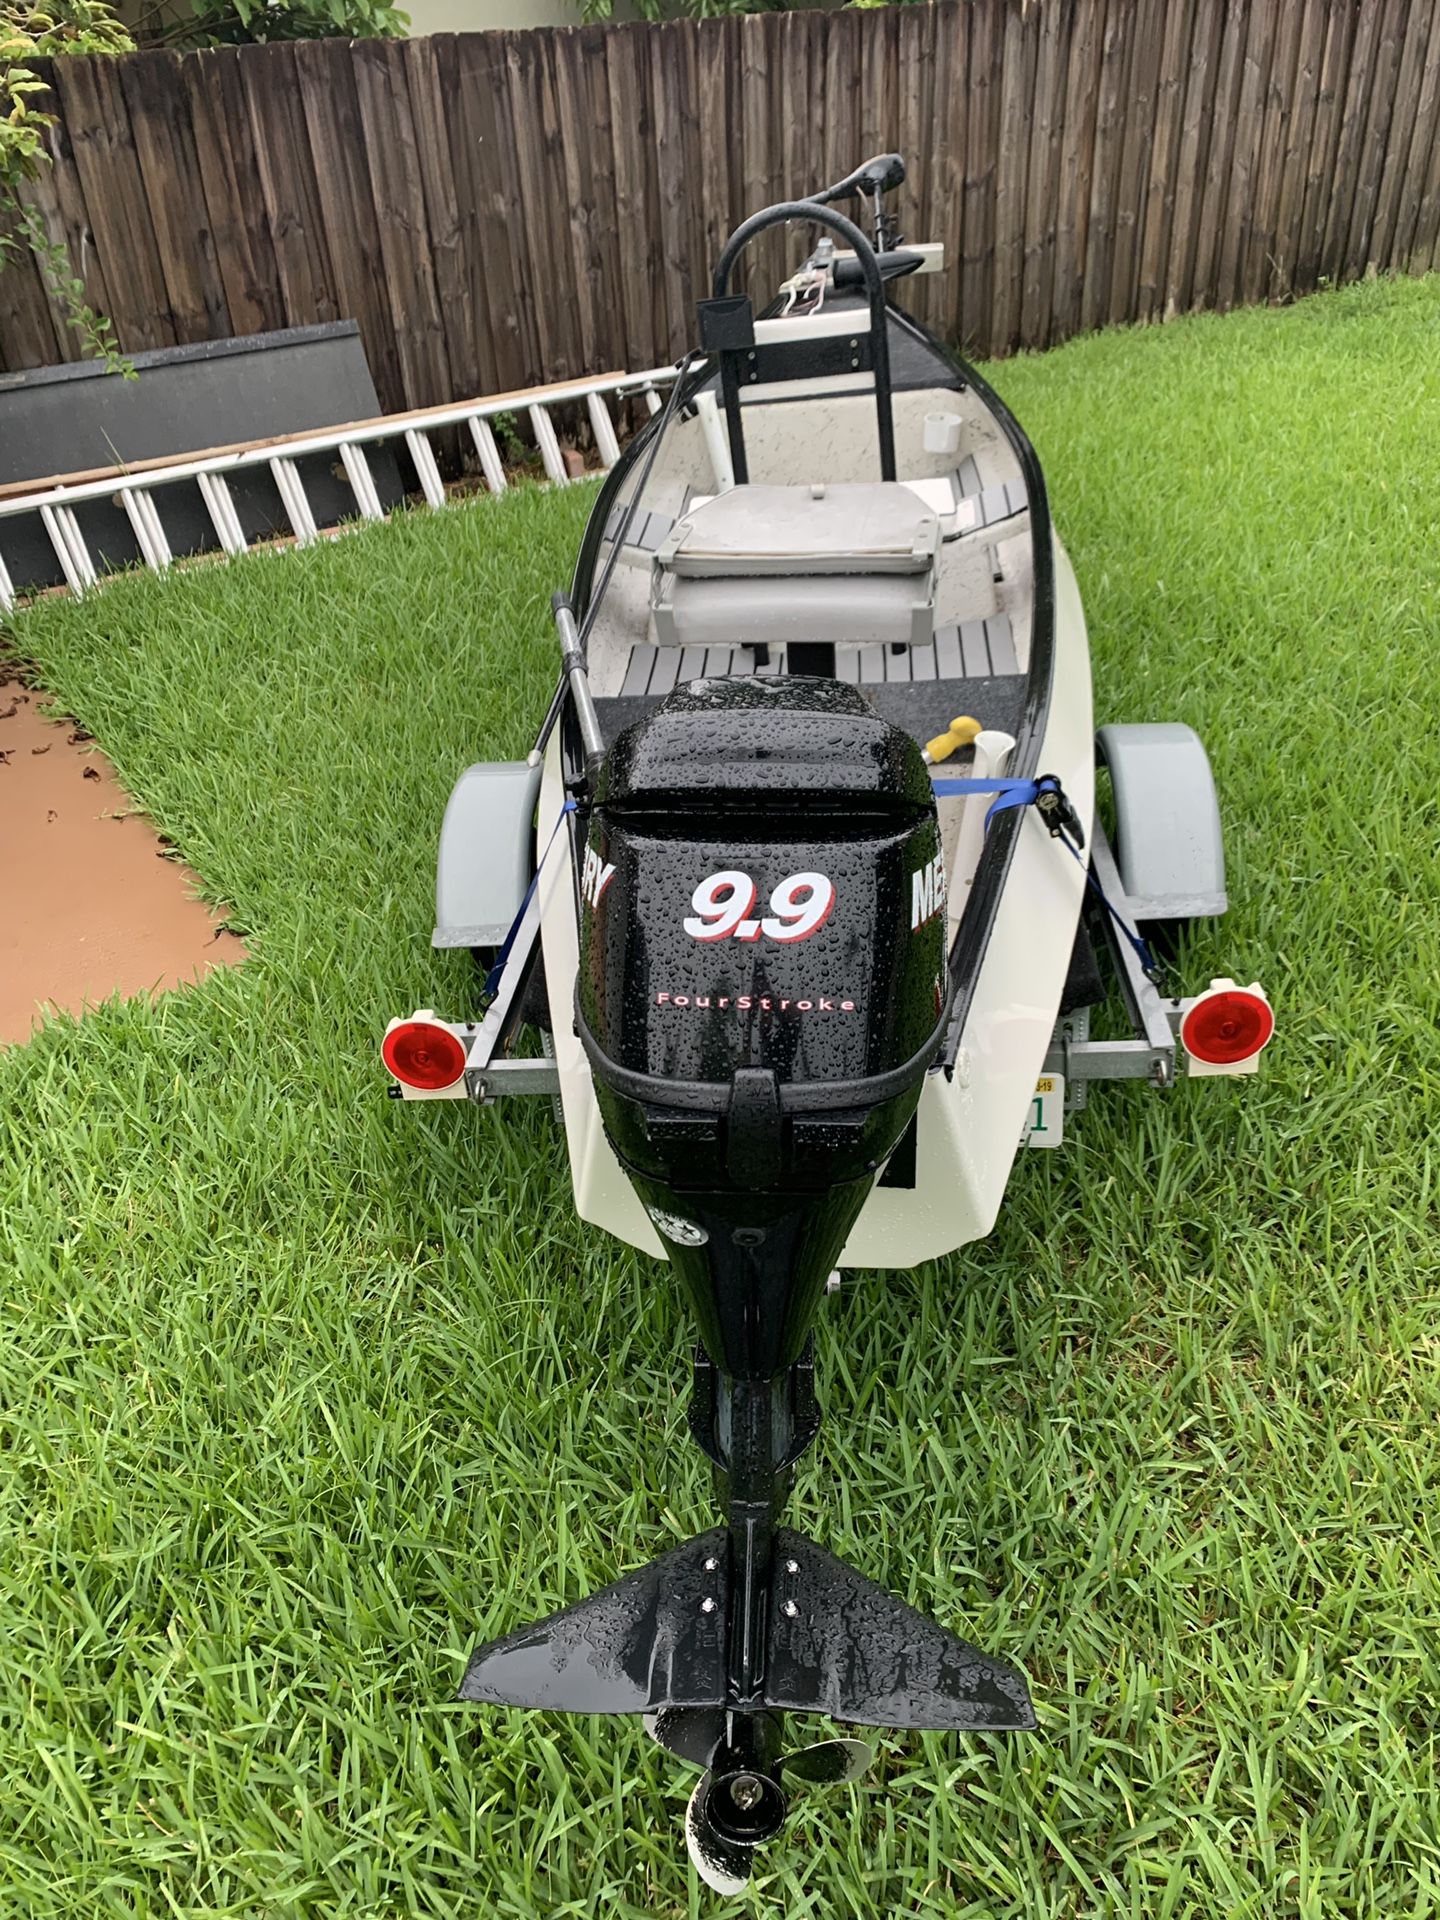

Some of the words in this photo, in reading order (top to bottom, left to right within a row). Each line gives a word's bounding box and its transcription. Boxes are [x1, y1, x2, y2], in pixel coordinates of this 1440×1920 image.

[683, 870, 836, 944] 9.9
[911, 848, 946, 932] ME
[656, 991, 855, 1011] FourStroke
